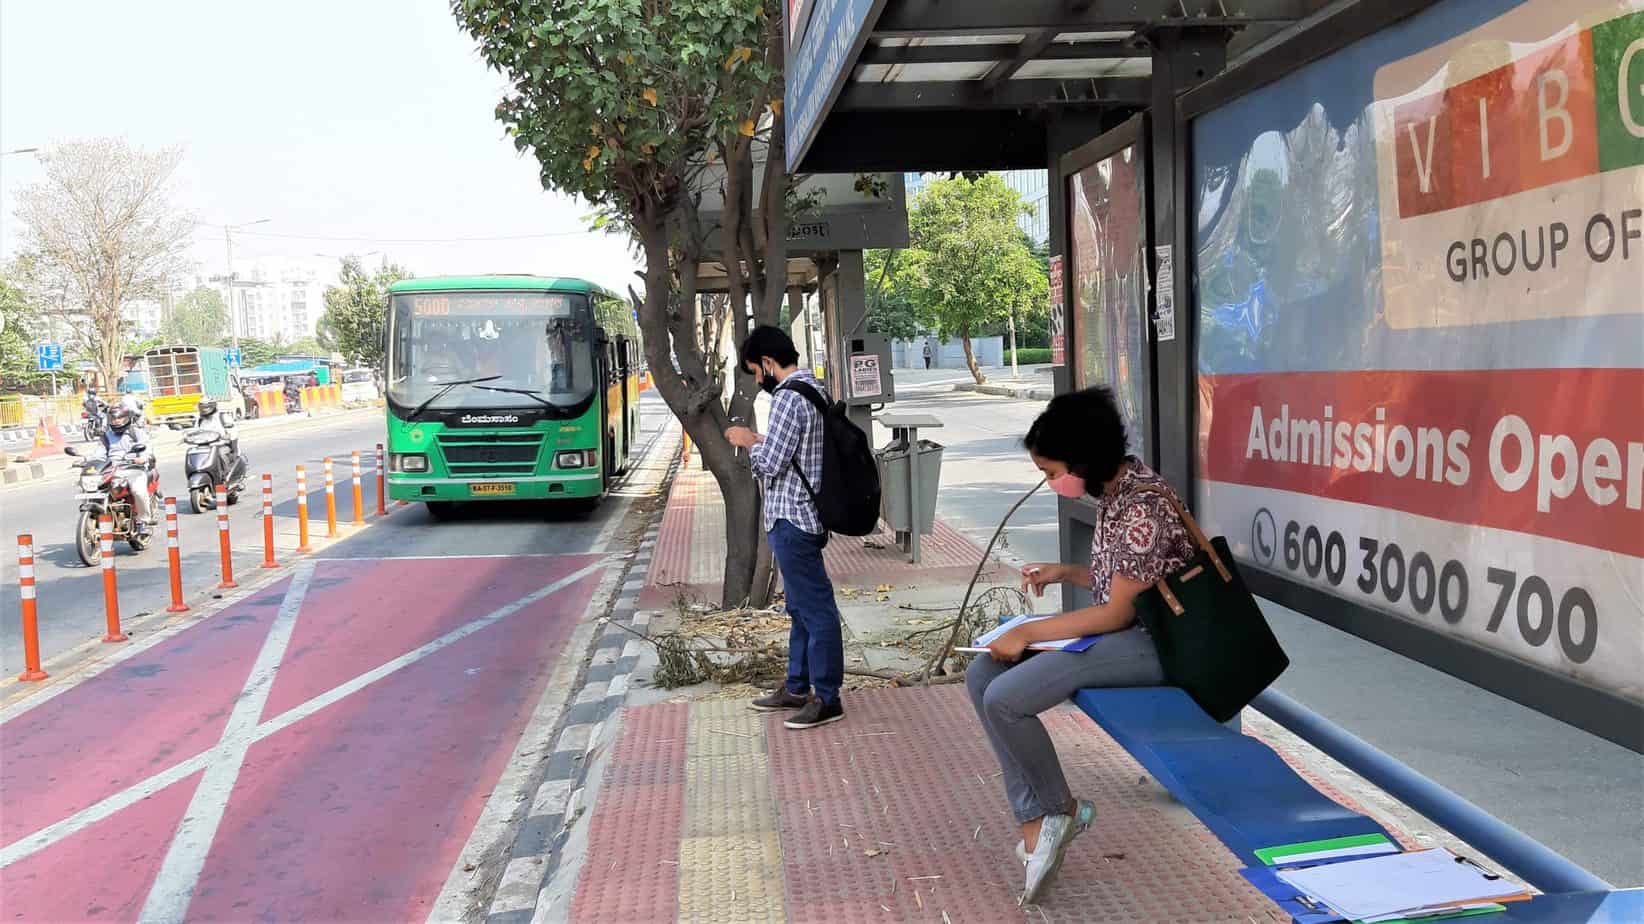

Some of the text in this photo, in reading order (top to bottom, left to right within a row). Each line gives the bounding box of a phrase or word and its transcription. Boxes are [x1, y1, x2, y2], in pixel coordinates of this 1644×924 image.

[1446, 208, 1642, 282] GROUP OF
[1246, 404, 1471, 486] Admissions
[1283, 520, 1598, 664] 600 3000 700
